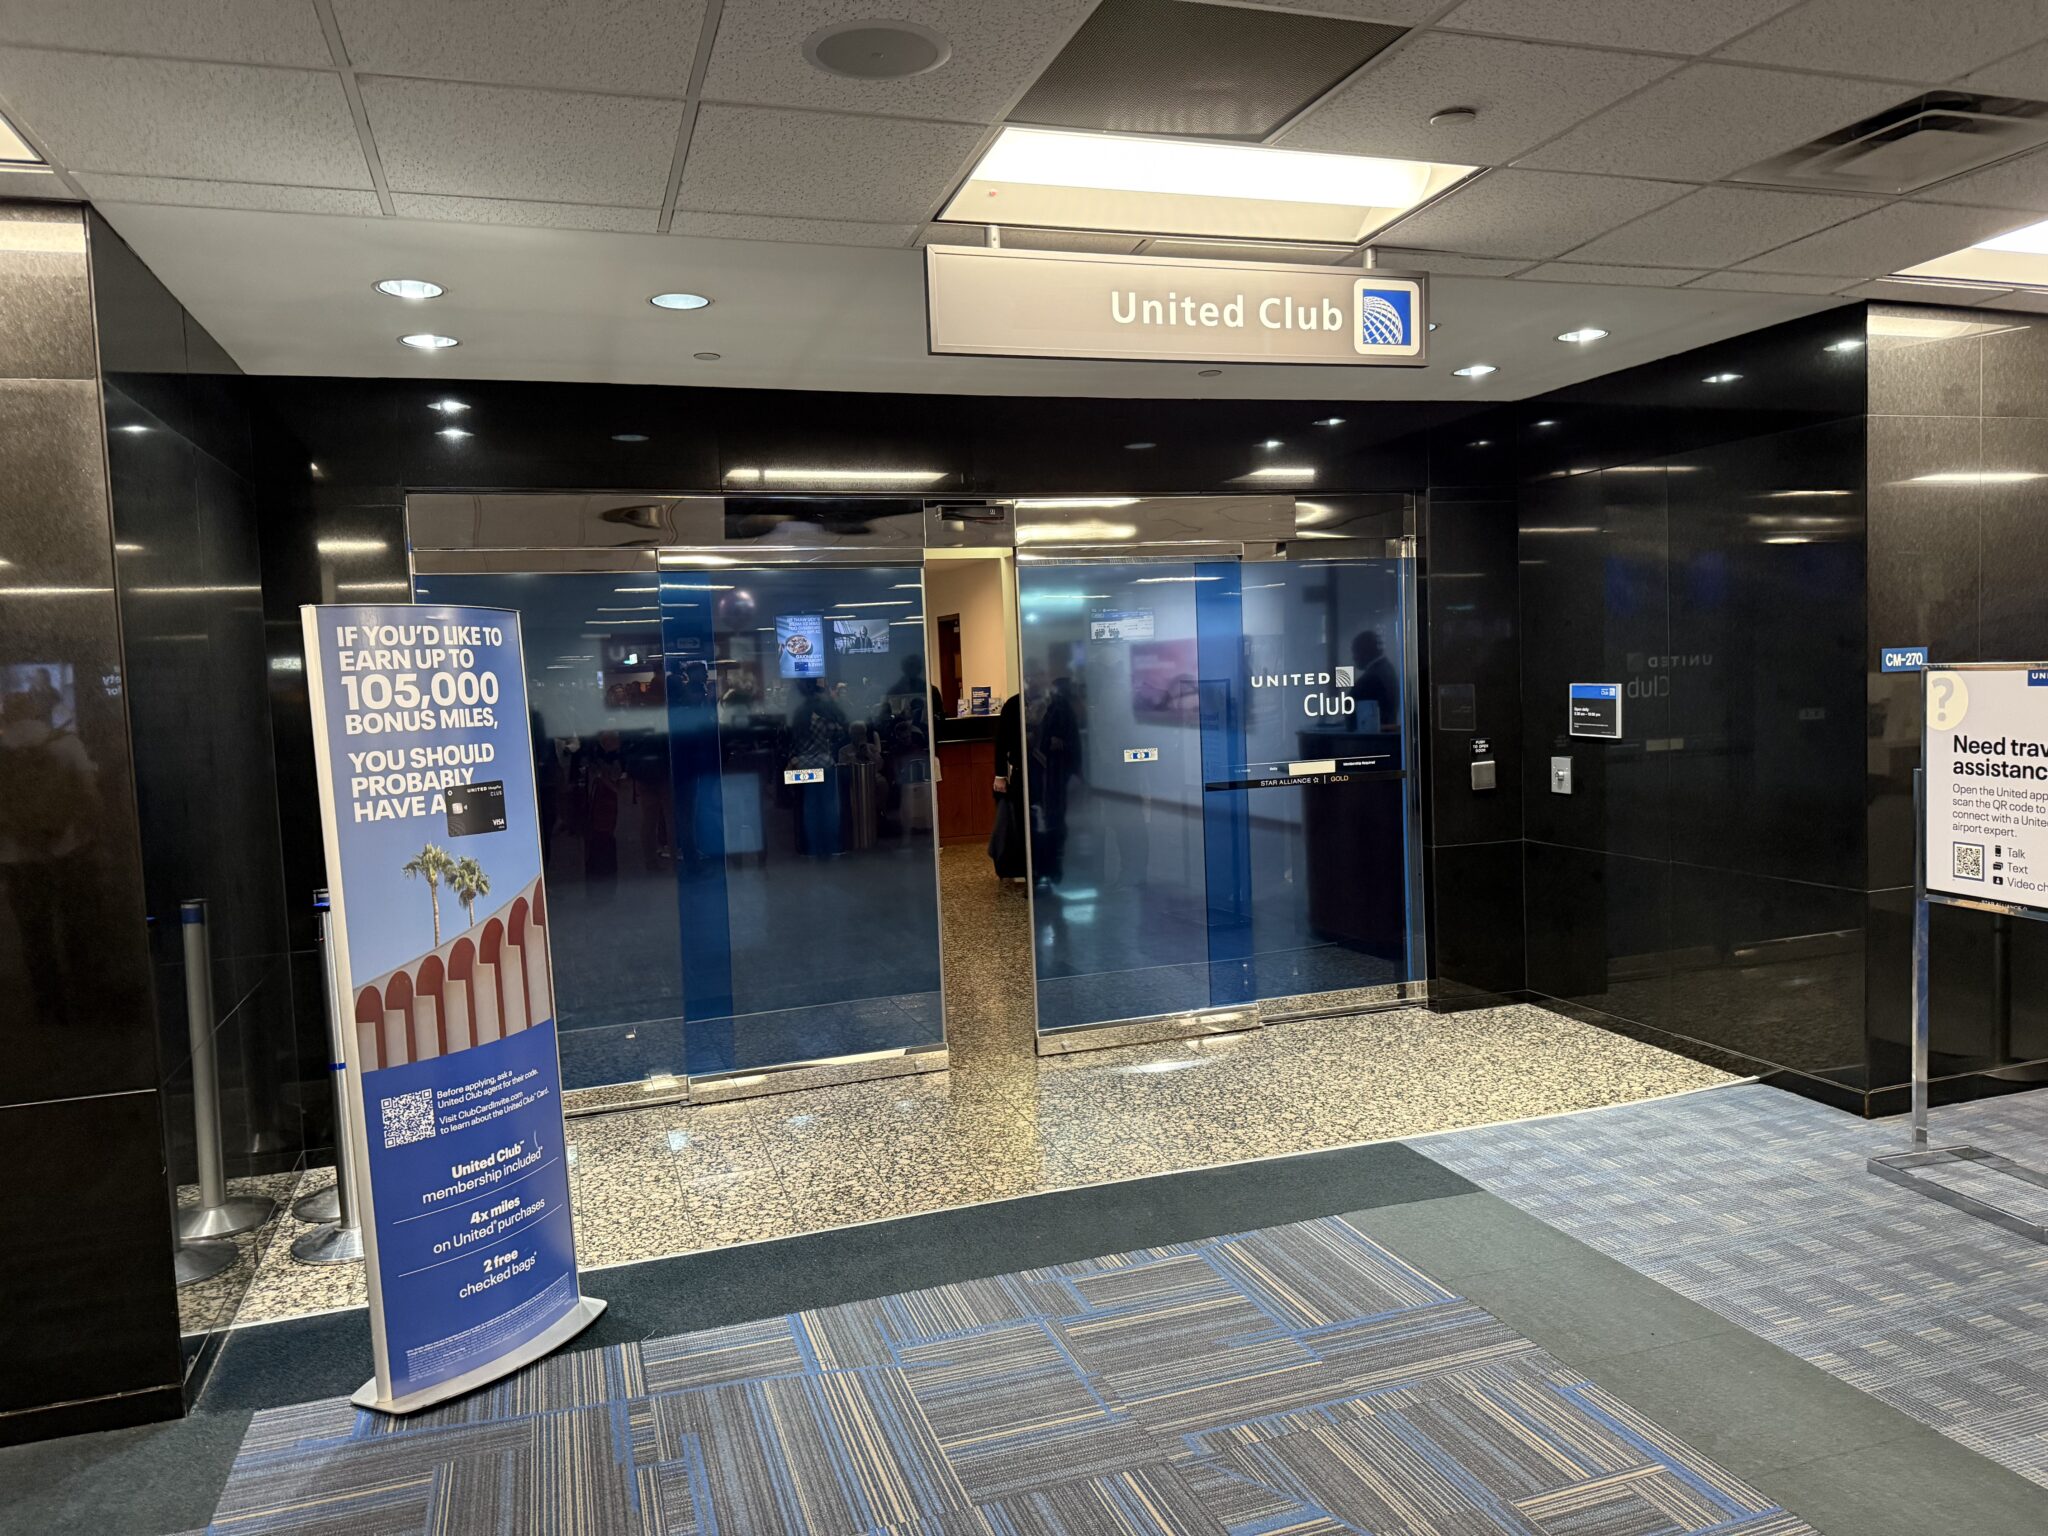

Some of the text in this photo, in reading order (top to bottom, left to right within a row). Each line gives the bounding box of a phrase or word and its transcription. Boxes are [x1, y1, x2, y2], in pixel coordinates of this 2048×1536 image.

[1111, 291, 1343, 332] United Club
[336, 625, 503, 647] IF YOU'D LIKE TO
[339, 648, 475, 671] EARN UP TO
[1885, 652, 1923, 667] CM-270
[341, 671, 499, 710] 105,000
[1251, 672, 1331, 688] UNITED
[1303, 691, 1355, 717] Club
[345, 707, 498, 735] BONUS MILES,
[1954, 734, 2048, 758] Need trav
[348, 743, 495, 773] YOU SHOULD
[1953, 758, 2048, 781] assistanc
[351, 767, 474, 798] PROBABLY
[1260, 779, 1278, 787] STAR
[1279, 777, 1312, 786] ALLIANCE
[1952, 783, 1978, 796] Open
[1979, 786, 1995, 797] the
[1996, 787, 2028, 799] United
[353, 794, 447, 823] HAVE A
[1952, 798, 2046, 814] scan the QR code to
[492, 818, 505, 826] VISA
[1952, 811, 1990, 822] connect
[1991, 813, 2012, 824] with
[2013, 817, 2019, 825] a
[1952, 822, 2017, 837] airport expert.
[2007, 847, 2026, 859] Talk
[2007, 862, 2028, 875] Text
[2007, 877, 2048, 892] Video ch
[436, 1086, 464, 1099] Before
[465, 1077, 496, 1093] applying,
[497, 1071, 508, 1081] ask
[437, 1068, 539, 1109] United Club agent for their code.
[439, 1114, 457, 1125] Visit
[440, 1126, 450, 1135] to
[450, 1120, 470, 1132] learn
[471, 1112, 492, 1126] about
[492, 1108, 504, 1119] the
[503, 1101, 523, 1114] United
[451, 1153, 495, 1179] United
[422, 1168, 502, 1204] membership
[470, 1196, 521, 1224] 4x miles
[433, 1239, 451, 1254] on
[497, 1198, 545, 1233] purchases
[483, 1250, 519, 1273] 2 free
[459, 1265, 511, 1299] checked
